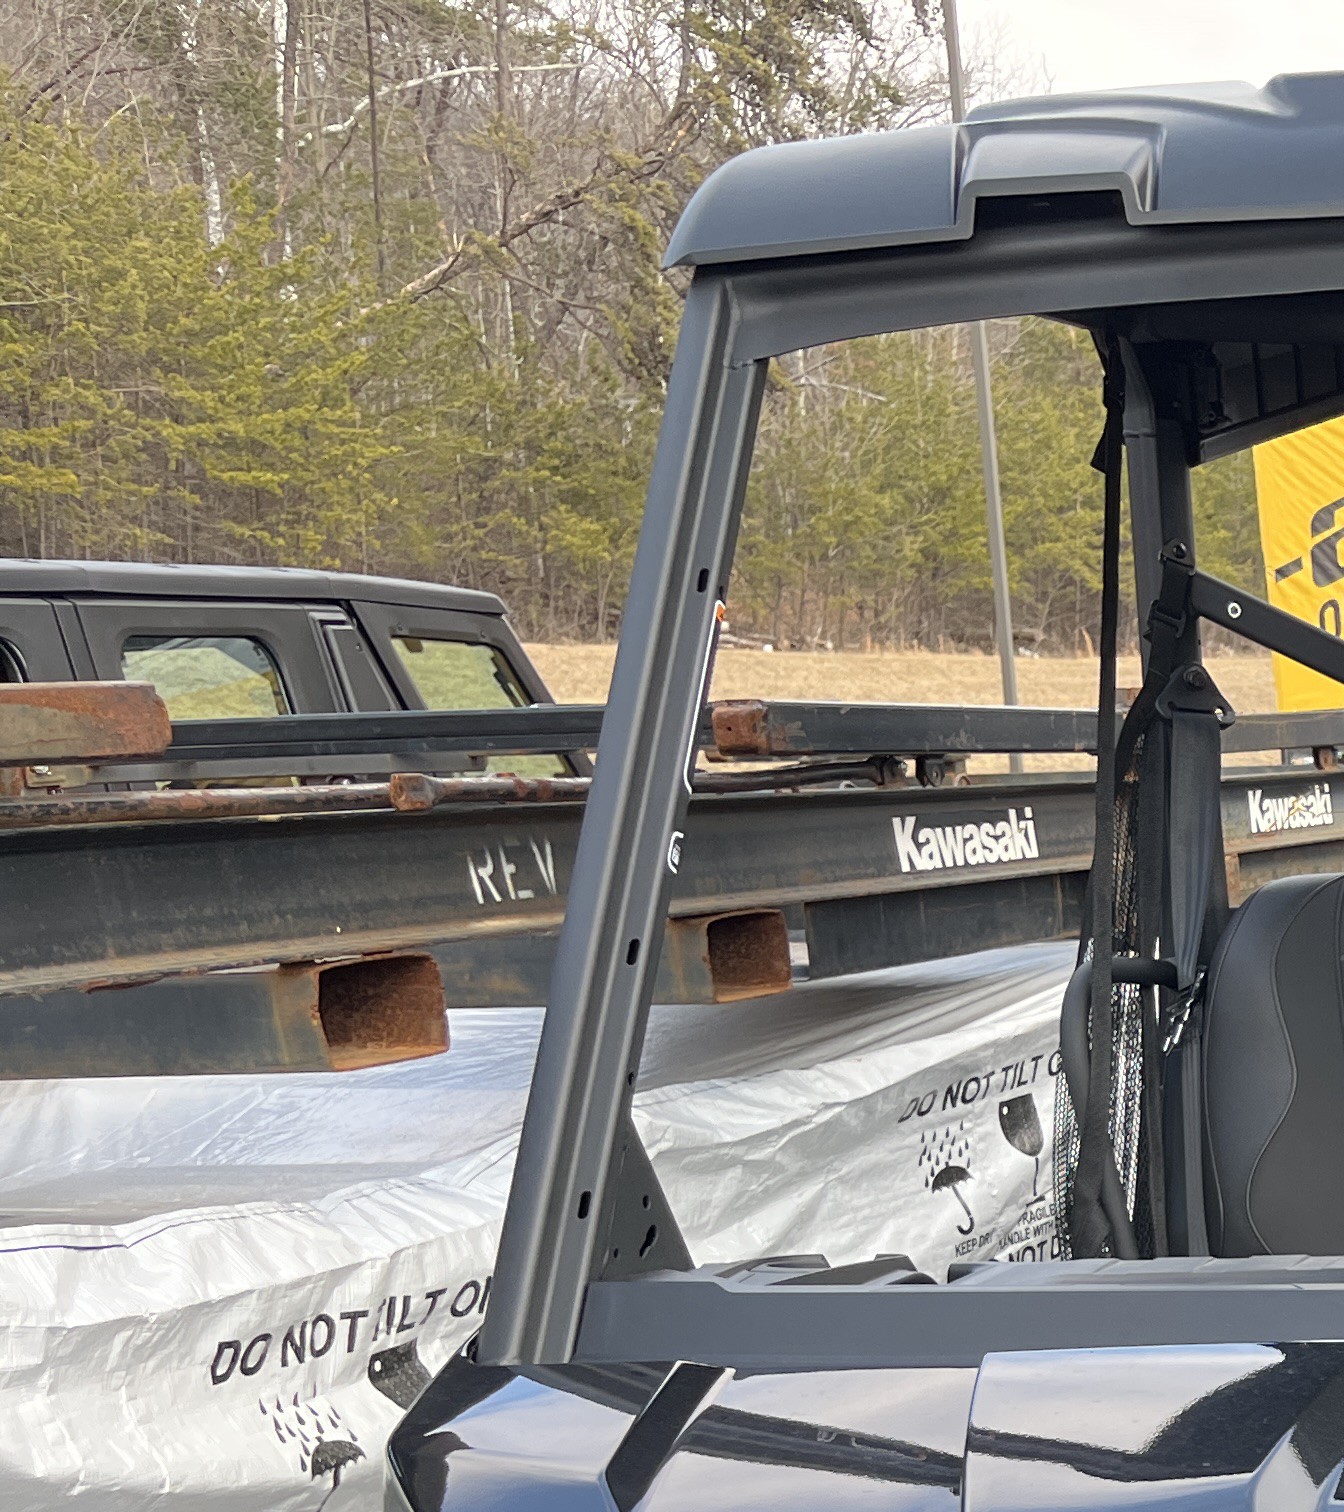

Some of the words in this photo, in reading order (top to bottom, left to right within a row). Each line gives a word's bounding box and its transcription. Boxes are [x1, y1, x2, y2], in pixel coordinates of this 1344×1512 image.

[892, 806, 1040, 872] Kawasaki
[1247, 783, 1333, 834] Kawasaki
[897, 1089, 938, 1123] DO
[942, 1071, 995, 1111] NOT
[1000, 1055, 1044, 1092] TILT
[954, 1238, 979, 1258] KEEP
[978, 1228, 995, 1248] DRY
[210, 1332, 273, 1385] DO
[281, 1309, 370, 1367] NOT
[371, 1287, 448, 1342] TILT
